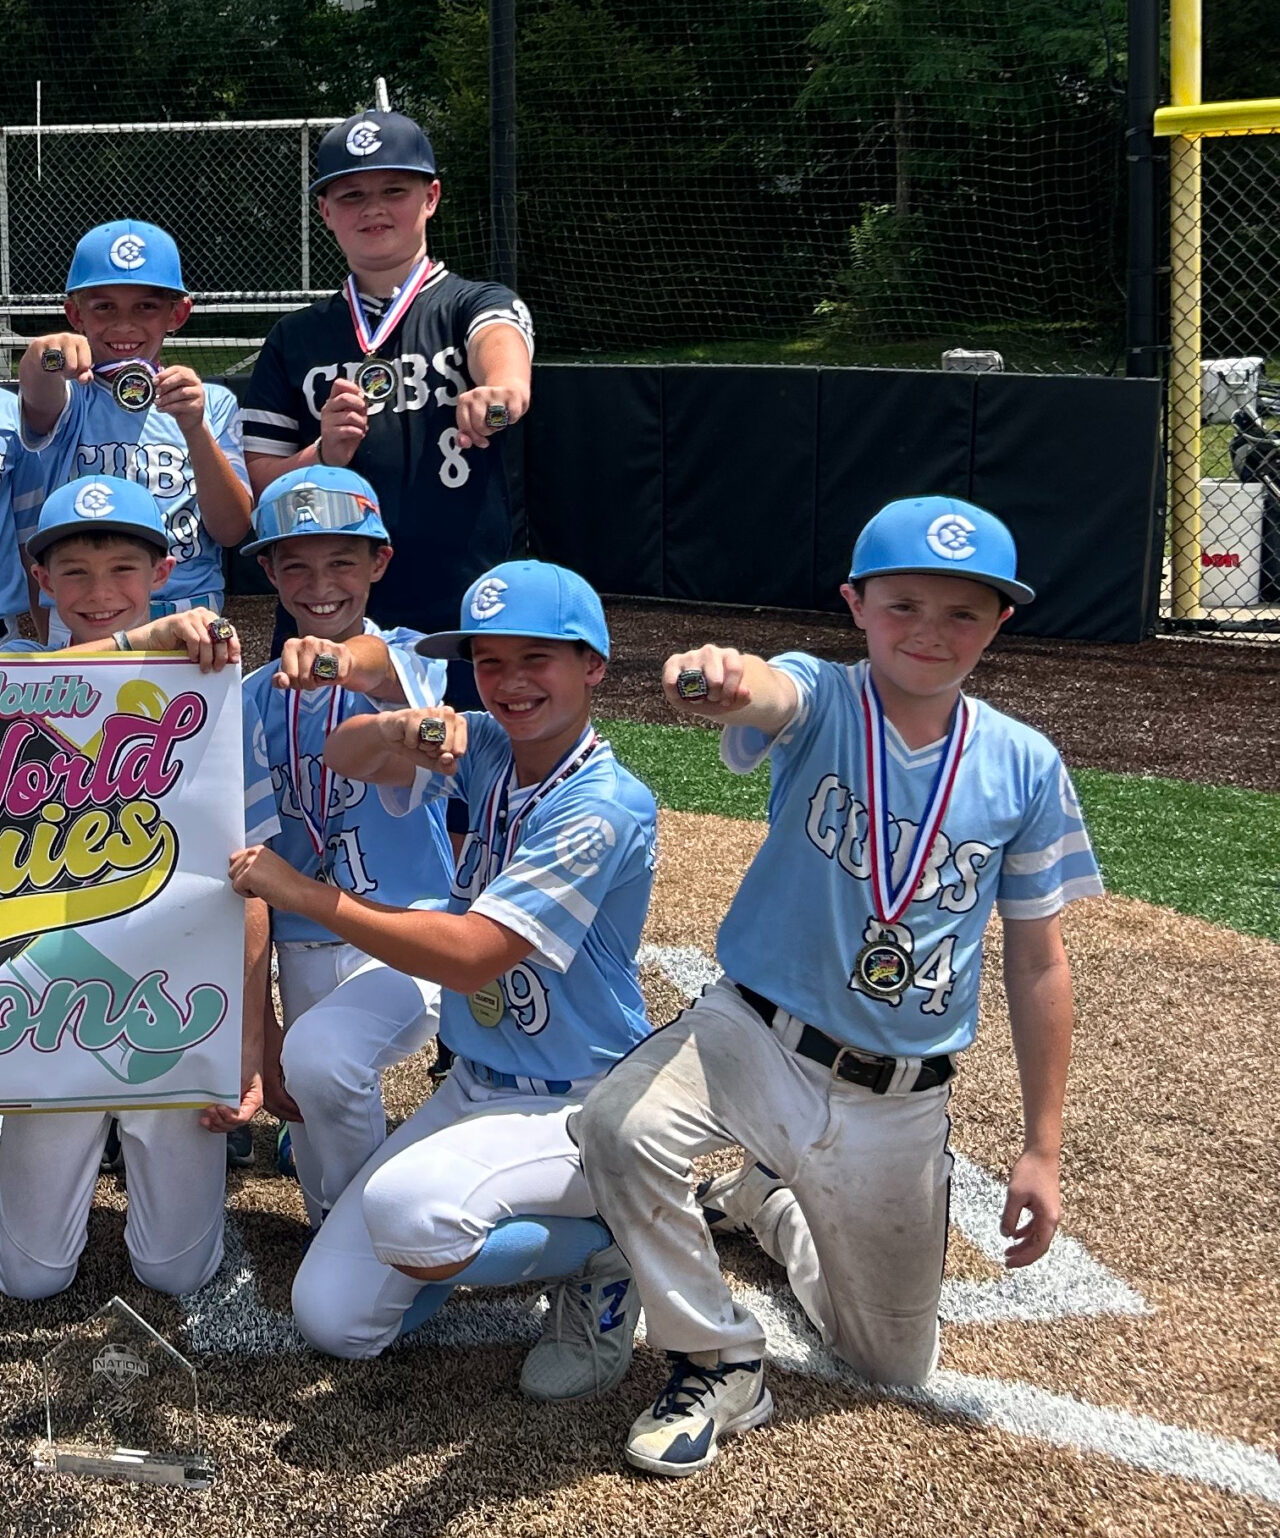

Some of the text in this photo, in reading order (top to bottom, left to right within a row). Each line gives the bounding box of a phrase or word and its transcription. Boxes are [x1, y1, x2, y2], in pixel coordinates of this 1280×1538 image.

[437, 427, 471, 488] 8
[806, 773, 1000, 914] CUBS
[93, 1357, 149, 1377] NATION
